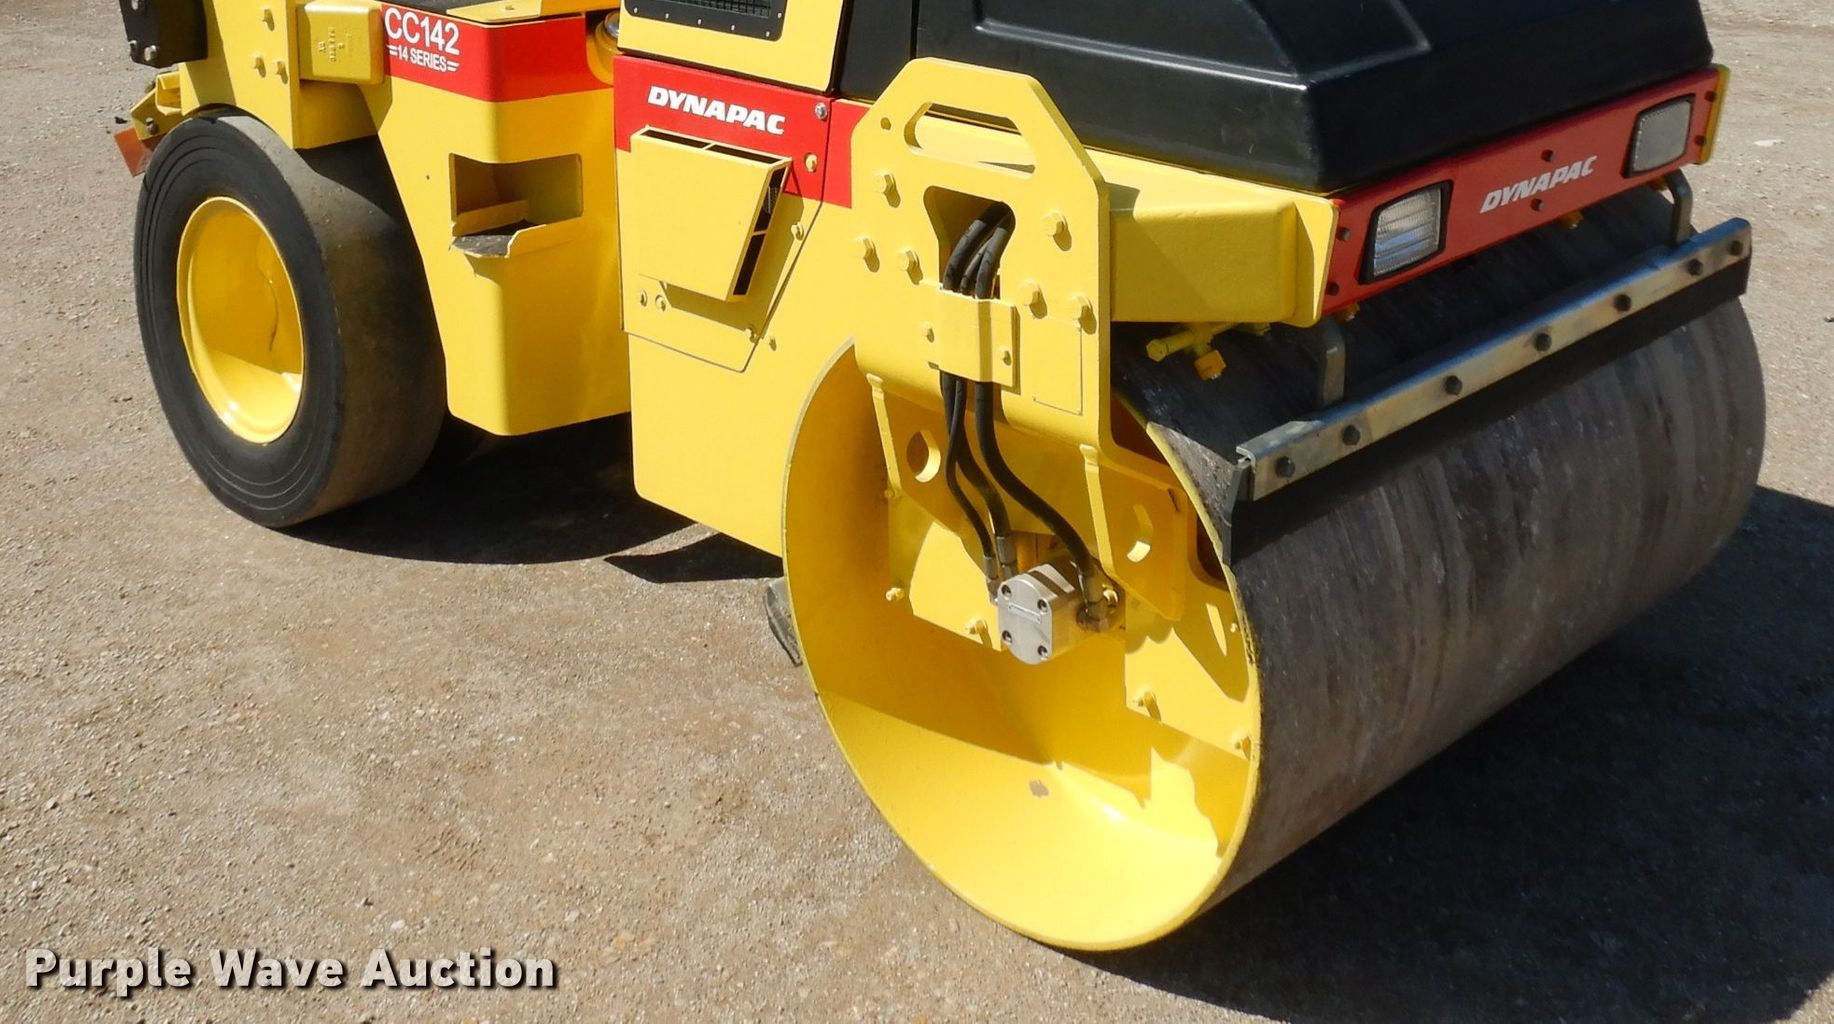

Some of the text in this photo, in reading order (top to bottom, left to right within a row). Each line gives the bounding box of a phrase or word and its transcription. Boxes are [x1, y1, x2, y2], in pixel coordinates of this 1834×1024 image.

[384, 7, 460, 56] CC142
[398, 45, 447, 72] 14 SERIES
[647, 85, 786, 136] DYNAPAC
[1479, 155, 1598, 214] DYNAPAC
